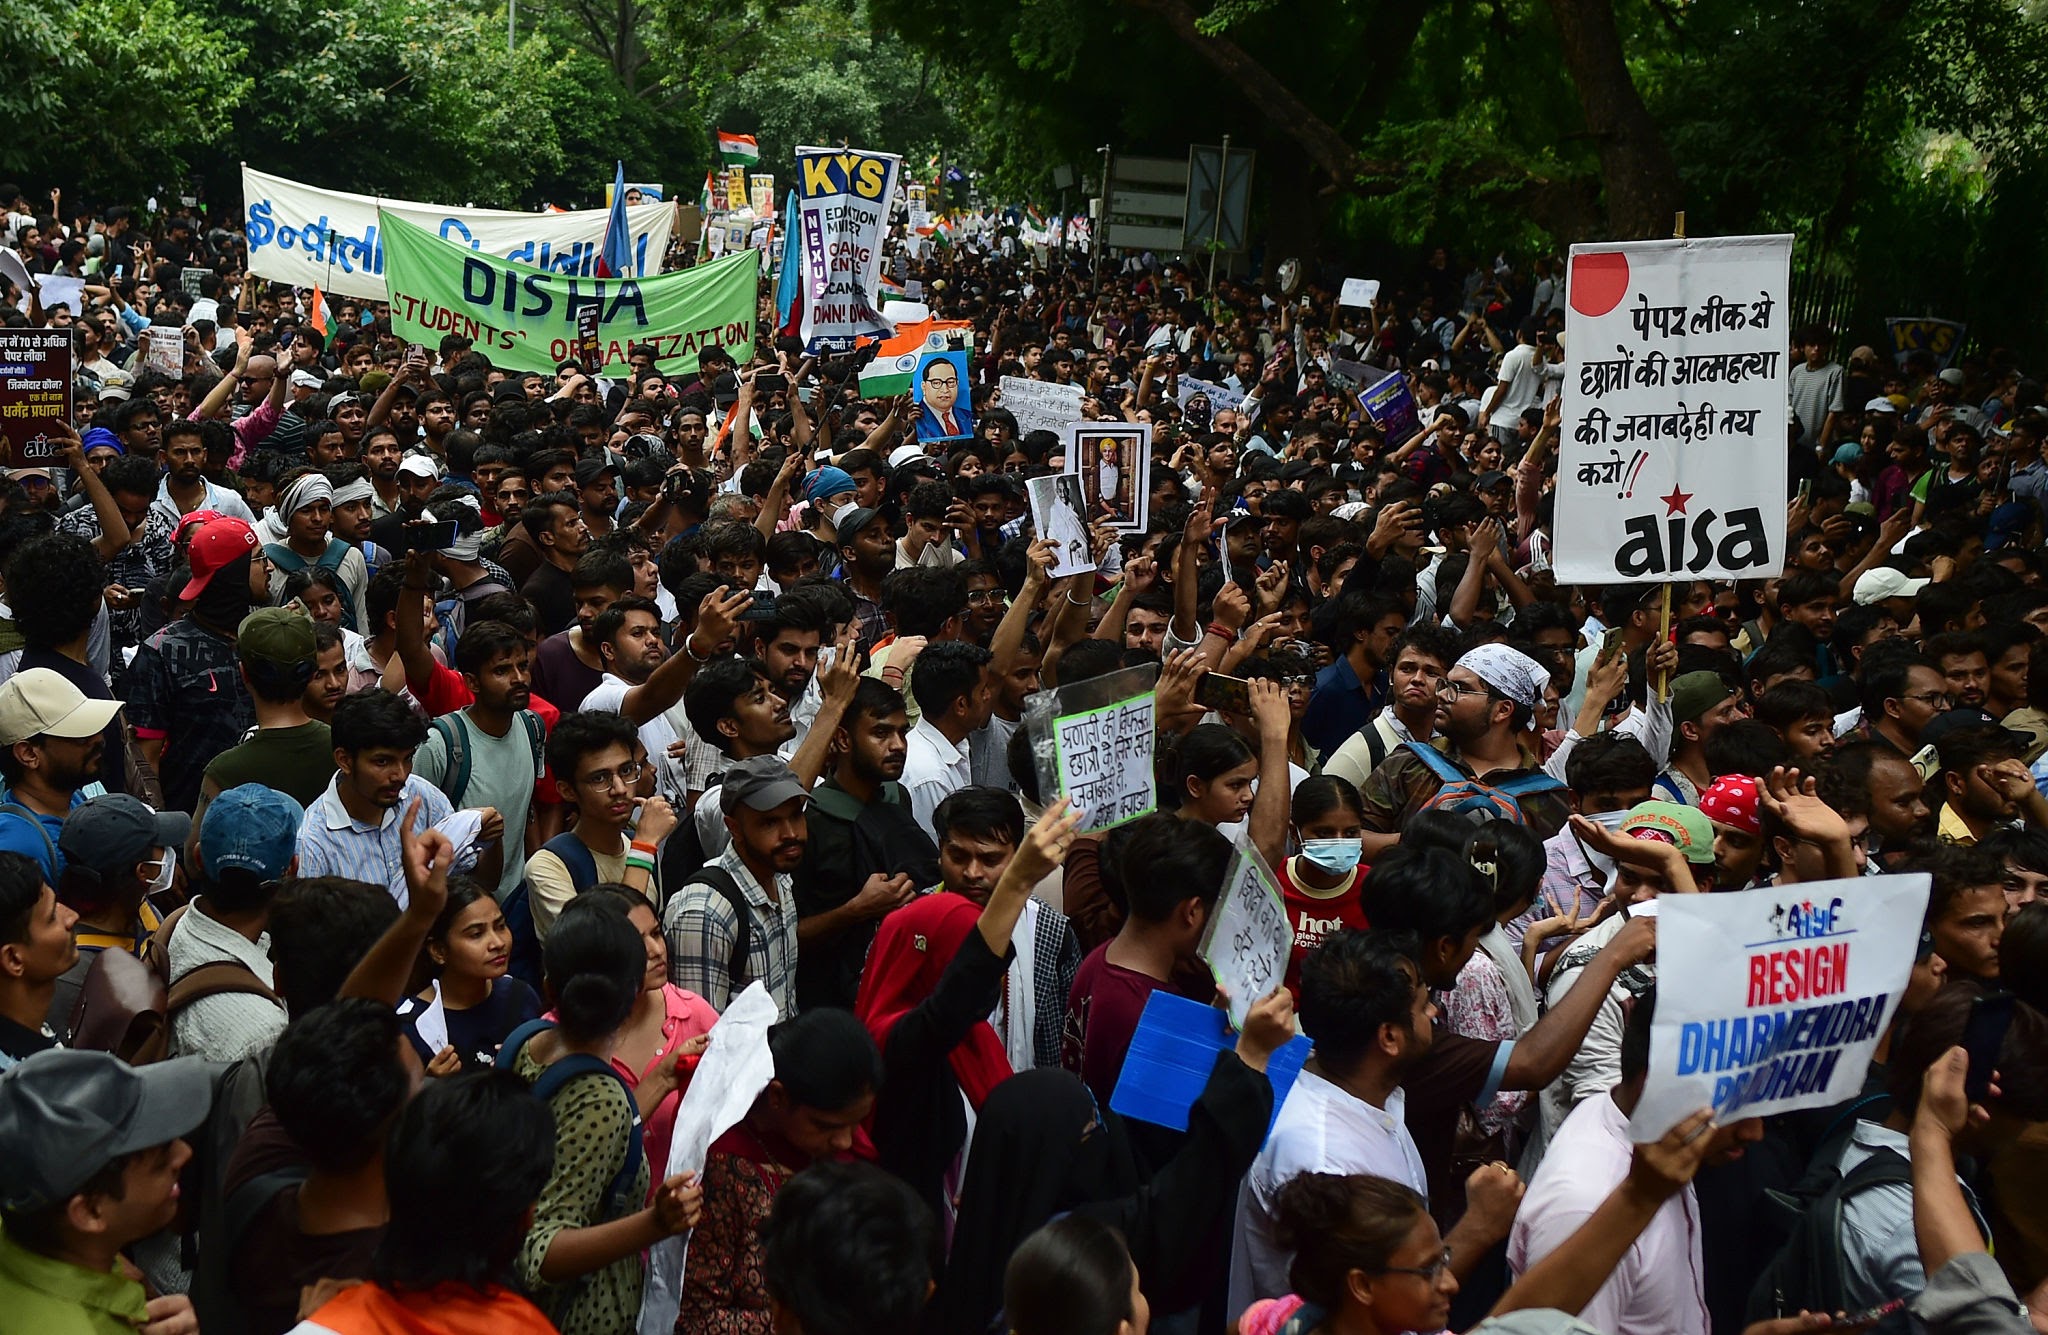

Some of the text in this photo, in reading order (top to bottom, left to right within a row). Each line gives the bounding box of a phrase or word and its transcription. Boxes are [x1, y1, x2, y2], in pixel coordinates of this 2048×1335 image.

[802, 154, 886, 199] KYS
[807, 215, 826, 295] NEXUS
[462, 256, 649, 325] DISHA
[813, 303, 846, 325] DWN!
[1630, 291, 1775, 341] पेपर लीक से
[9, 334, 19, 348] में
[20, 337, 31, 348] 70
[32, 334, 41, 348] से
[42, 334, 68, 348] अधिक
[1894, 322, 1955, 354] KYS
[4, 349, 46, 362] पेपर लीक!
[1580, 344, 1780, 399] छात्रों की आत्महत्या
[29, 392, 63, 402] एक ही नाम
[42, 378, 63, 391] कौन?
[31, 404, 65, 419] प्रधान!
[1575, 401, 1761, 445] की जवाबदेही तय
[1614, 503, 1770, 578] aisa
[1102, 710, 1115, 739] की
[1620, 813, 1656, 830] RIPLE
[1298, 911, 1343, 935] hot
[1746, 943, 1850, 1008] RESIGN
[1676, 992, 1889, 1077] DHARMENDRA
